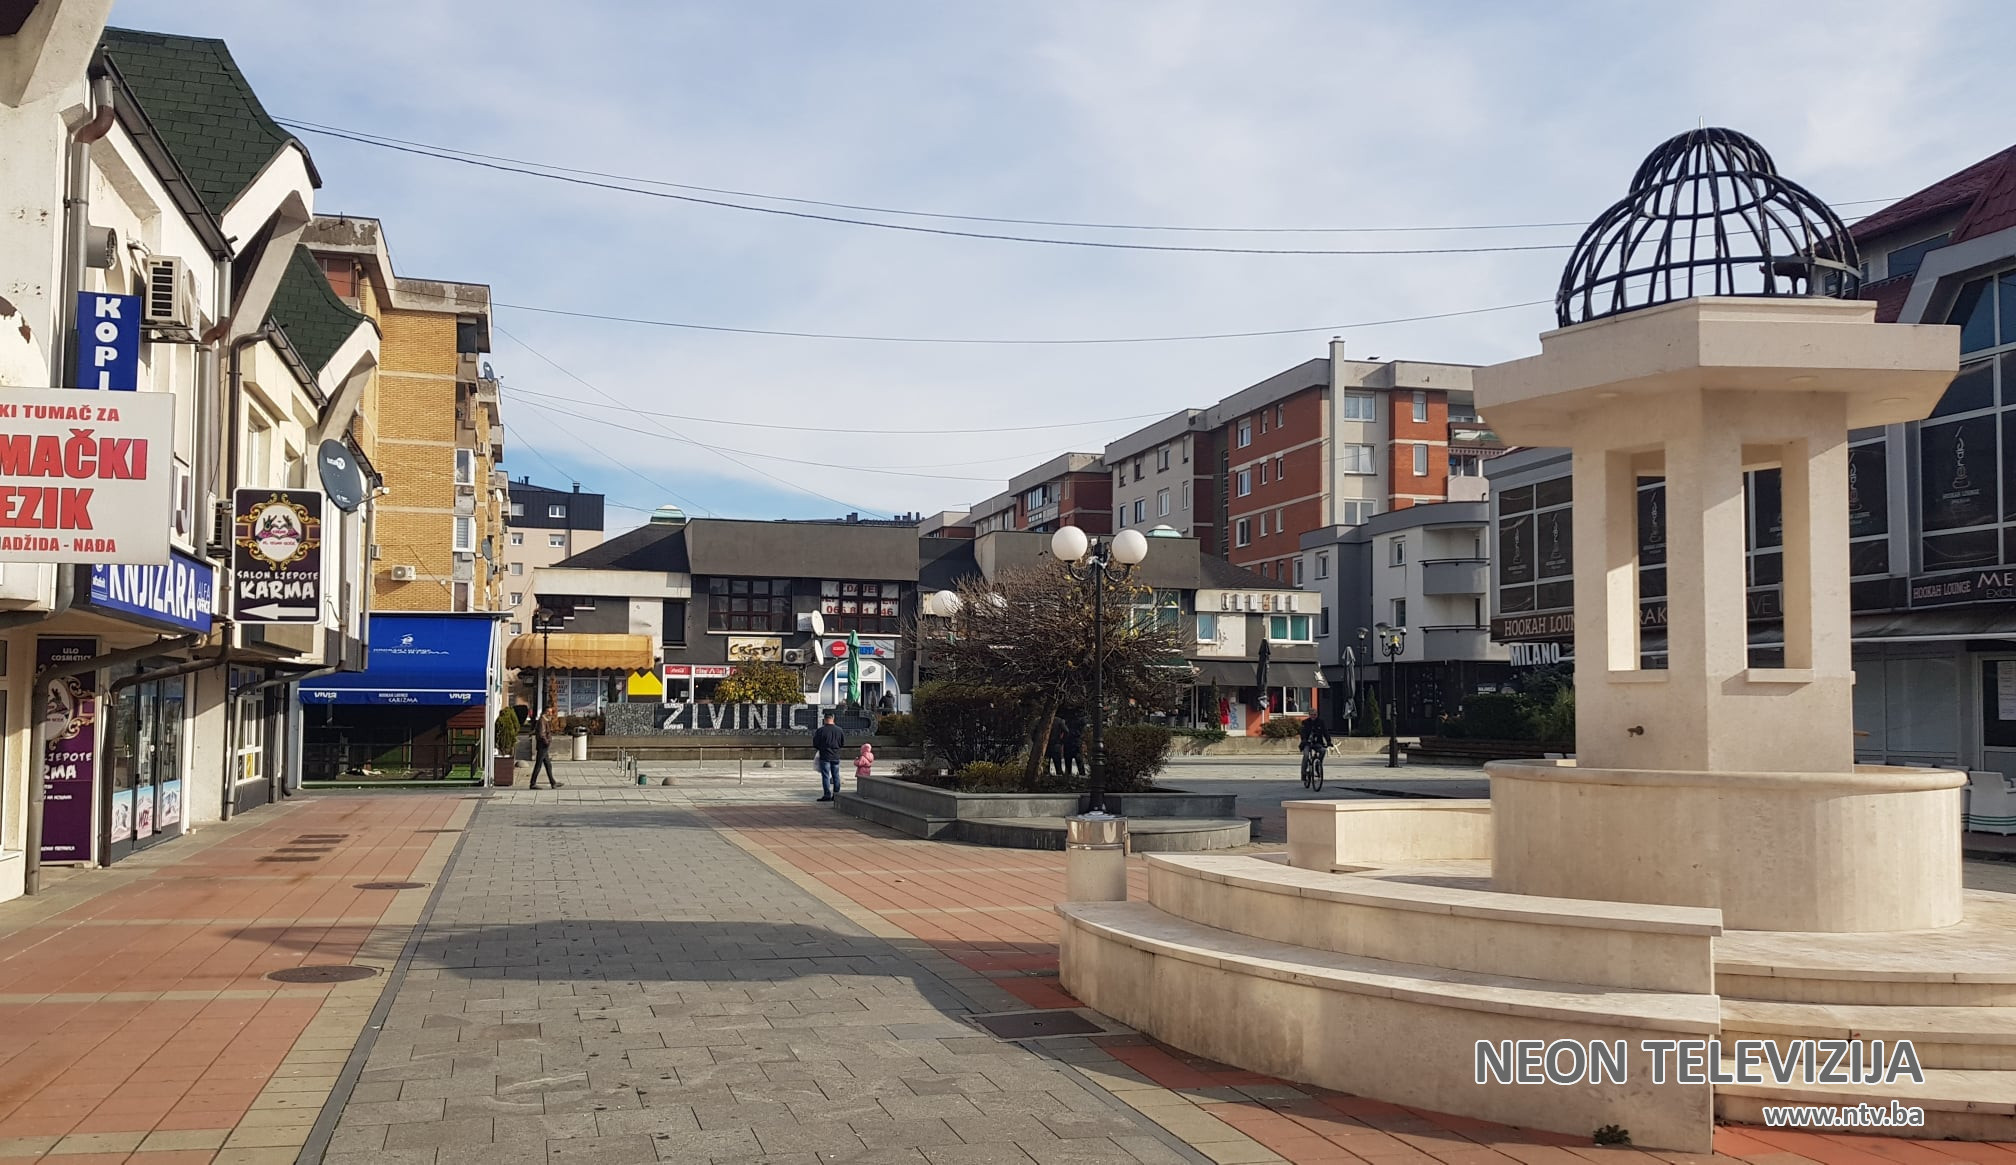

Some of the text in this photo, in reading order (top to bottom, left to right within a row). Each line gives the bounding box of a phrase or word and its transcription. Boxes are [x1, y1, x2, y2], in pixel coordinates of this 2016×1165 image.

[23, 404, 92, 421] TUMAČ
[96, 407, 120, 422] ZA
[0, 485, 94, 530] EZIK
[0, 534, 60, 551] ADŽIDA
[237, 571, 318, 581] SALON LJEPOTE
[1977, 572, 2014, 588] ME
[240, 580, 315, 600] KARMA
[1504, 616, 1547, 637] HOOKAH
[1509, 642, 1561, 667] MILANO
[45, 752, 92, 762] JEPOTE
